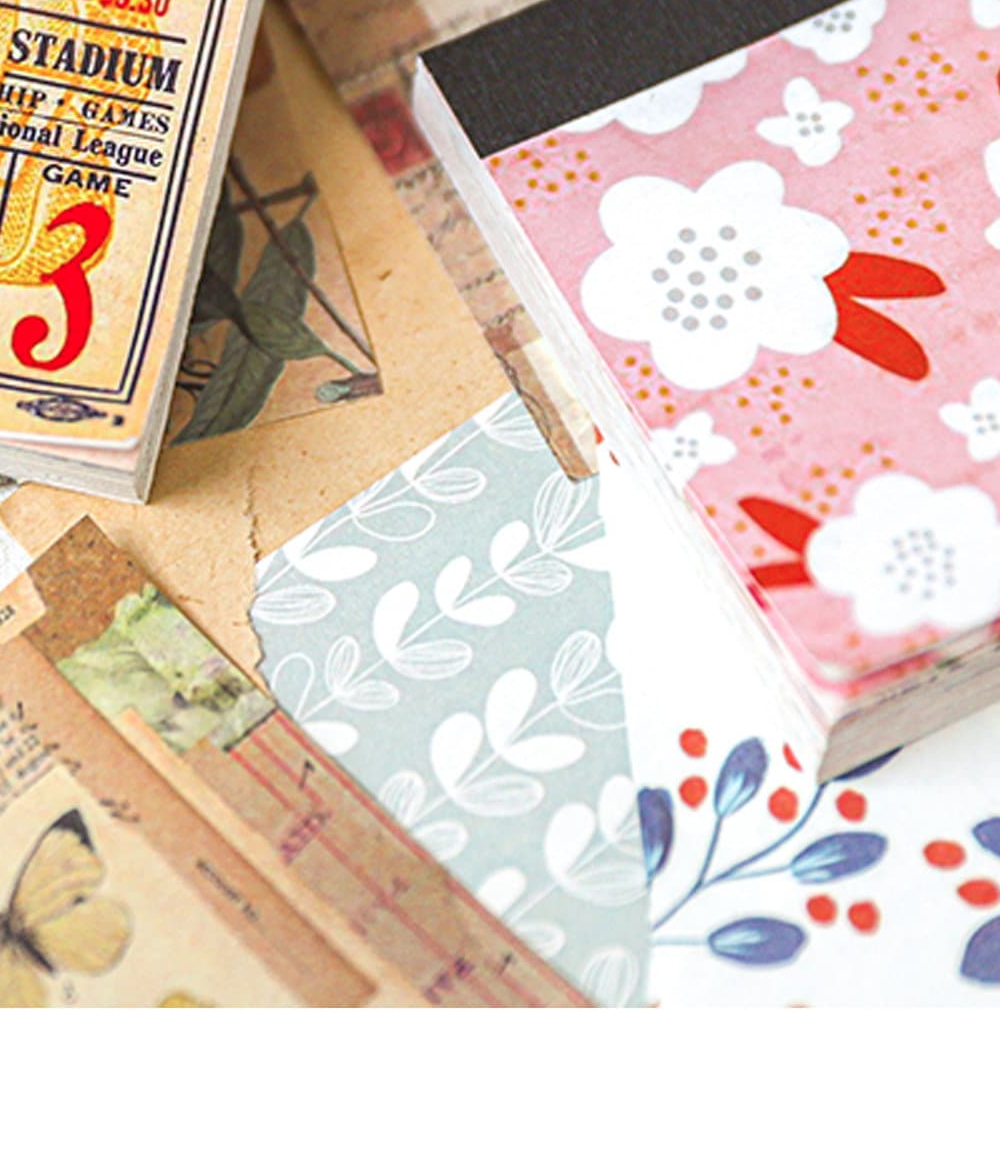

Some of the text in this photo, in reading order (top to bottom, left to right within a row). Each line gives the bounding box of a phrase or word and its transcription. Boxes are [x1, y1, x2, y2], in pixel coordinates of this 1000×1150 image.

[7, 27, 183, 94] STADIUM
[81, 99, 171, 135] GAMES
[72, 124, 164, 168] League
[42, 163, 133, 198] GAME
[11, 201, 112, 372] 3
